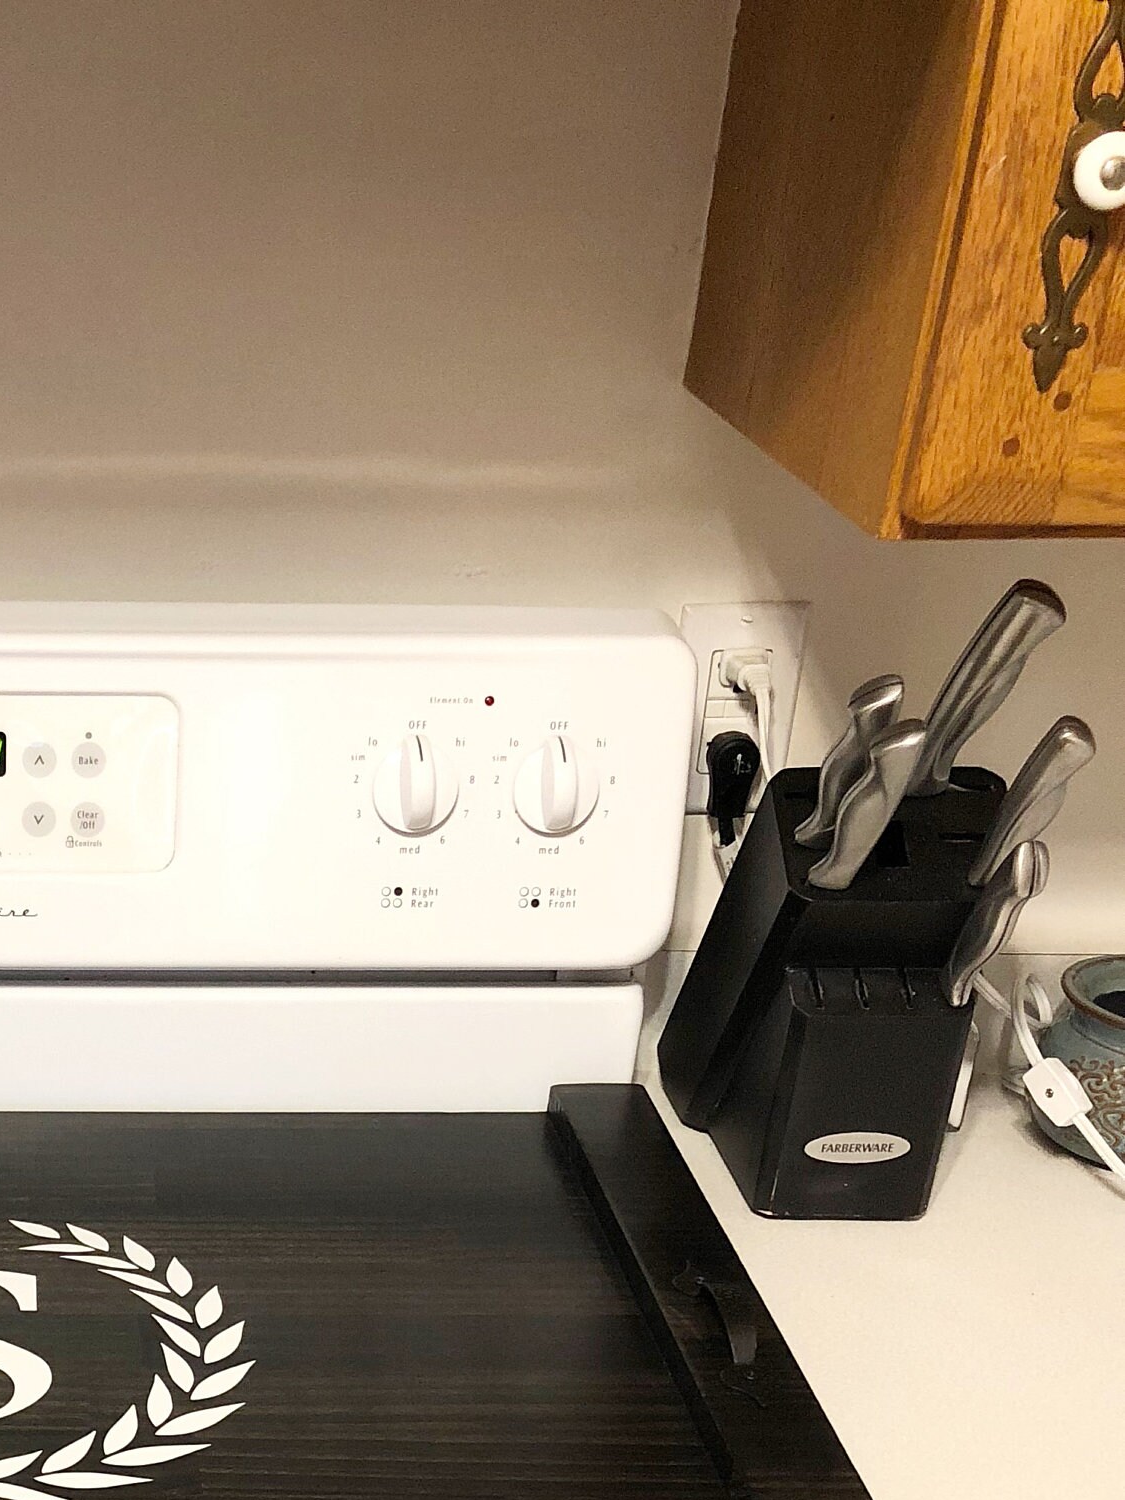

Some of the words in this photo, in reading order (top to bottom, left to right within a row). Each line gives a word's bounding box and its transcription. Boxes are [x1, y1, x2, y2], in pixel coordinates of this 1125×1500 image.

[409, 720, 427, 729] OFF
[550, 721, 569, 730] OFF
[368, 737, 378, 747] lo
[456, 737, 465, 747] hi
[509, 738, 519, 747] lo
[597, 737, 607, 748] hi
[78, 756, 99, 765] Bake
[351, 753, 365, 761] sim
[353, 775, 359, 784] 2
[469, 775, 475, 784] 8
[494, 775, 499, 784] 2
[610, 776, 615, 785] 8
[77, 810, 99, 819] Clear
[356, 810, 361, 818] 3
[464, 810, 469, 819] 7
[496, 810, 501, 819] 3
[604, 810, 609, 819] 7
[375, 836, 381, 845] 4
[440, 836, 445, 845] 6
[515, 837, 520, 845] 4
[579, 836, 584, 845] 6
[399, 845, 420, 855] med
[538, 846, 559, 855] med
[411, 887, 439, 898] Right
[550, 887, 576, 898] Right
[411, 899, 434, 908] Rear
[549, 899, 576, 908] Front
[820, 1142, 895, 1153] FARBERWARE
